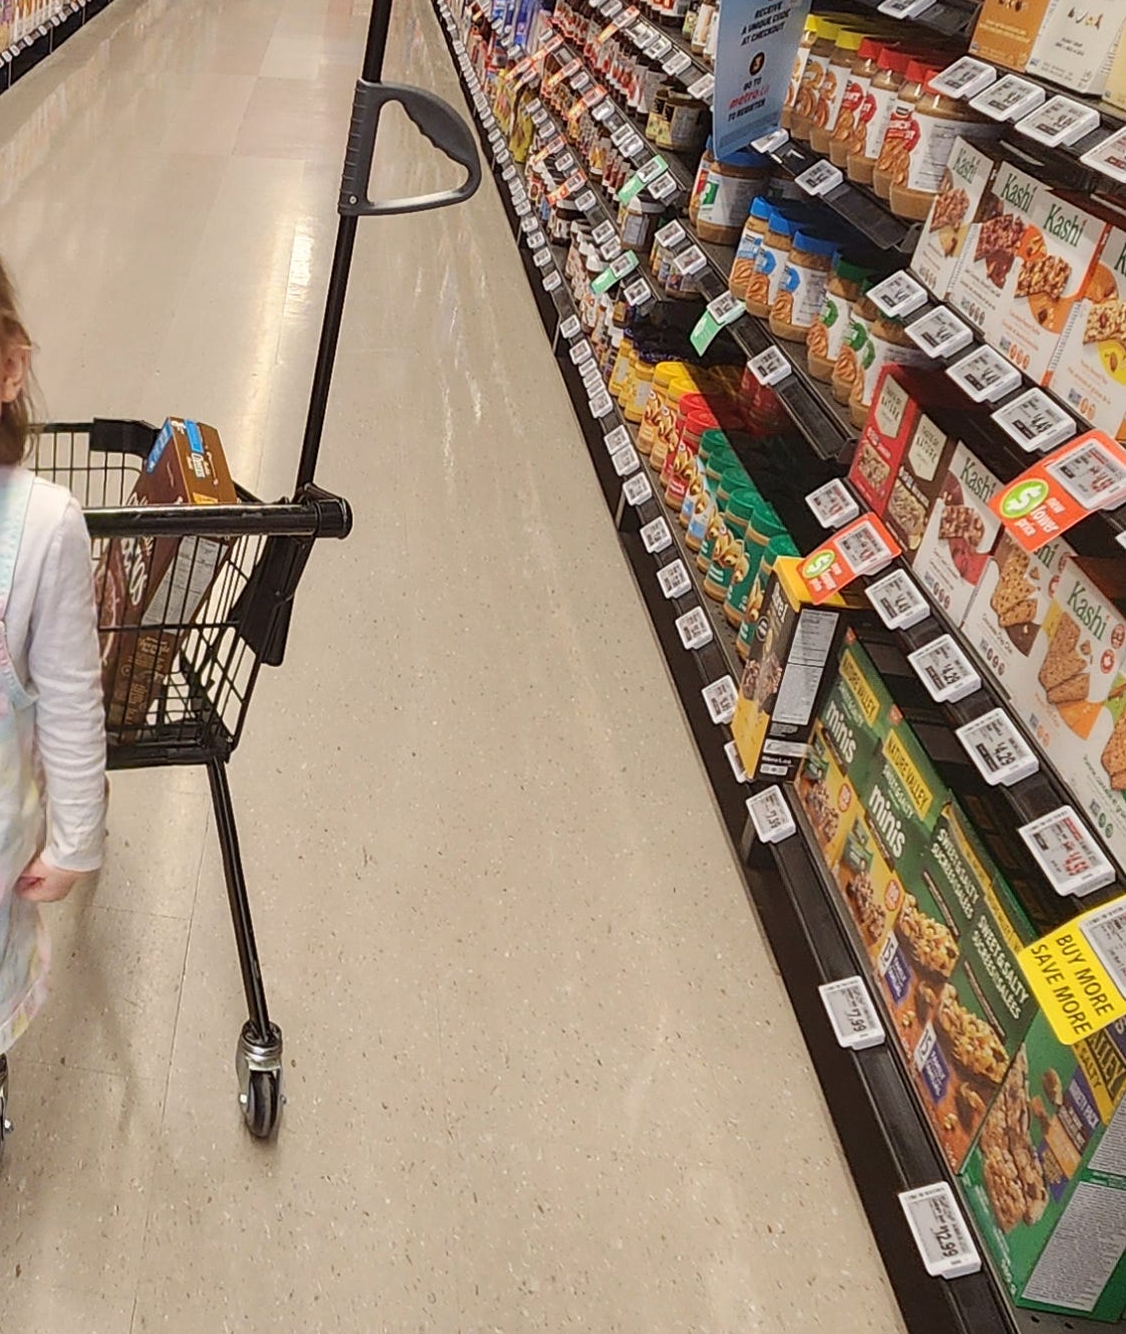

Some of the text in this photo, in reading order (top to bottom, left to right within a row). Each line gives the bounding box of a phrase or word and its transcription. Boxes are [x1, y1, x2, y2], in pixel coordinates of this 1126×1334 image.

[748, 14, 772, 32] UNIQUE
[754, 2, 782, 19] RECEIVE
[740, 22, 785, 46] AT CHECKOUT
[752, 77, 763, 88] TO
[955, 147, 981, 185] Kashi
[1000, 173, 1038, 214] Kashi
[1042, 203, 1088, 248] Kashi
[959, 457, 996, 504] Kashi
[1030, 505, 1059, 533] lower
[817, 567, 838, 593] lower
[1066, 580, 1111, 641] Kashi
[822, 699, 864, 764] minis
[886, 736, 928, 808] NATURE VALLEY
[865, 784, 912, 858] minis
[1030, 942, 1094, 1036] SAVE MORE
[1056, 933, 1115, 1017] BUY MORE
[1077, 1048, 1102, 1088] SALTY
[938, 1220, 968, 1258] $12.99
